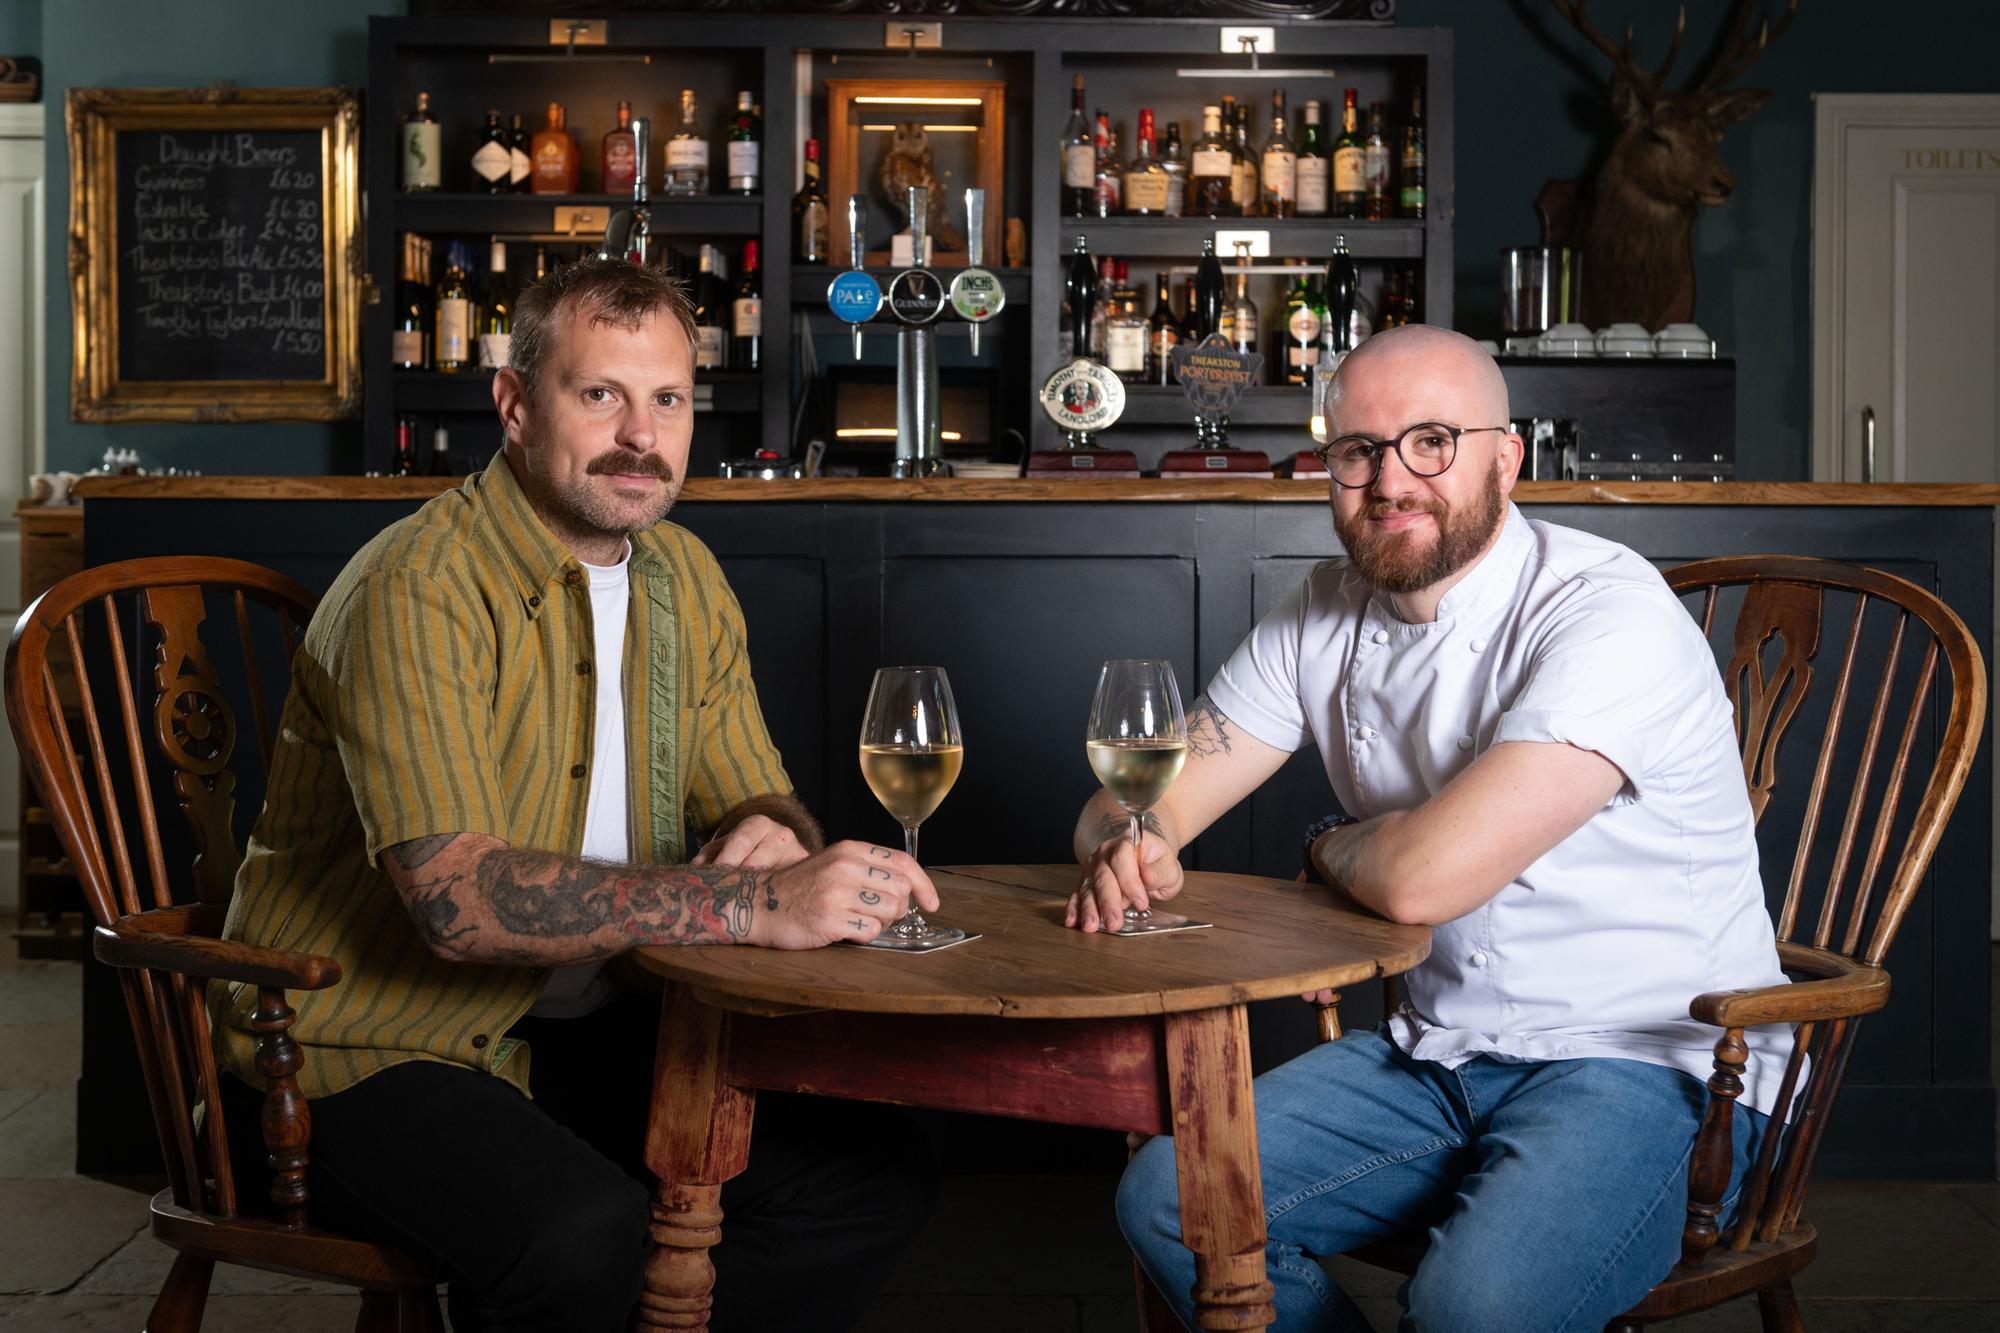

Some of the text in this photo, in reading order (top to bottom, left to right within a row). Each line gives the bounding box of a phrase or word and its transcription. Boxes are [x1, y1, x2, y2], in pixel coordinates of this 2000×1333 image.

[159, 132, 296, 171] Draught Beers
[1900, 148, 2000, 169] TOILETS
[894, 298, 938, 308] GUINNESS
[1190, 355, 1241, 369] THEAKSTON
[1047, 367, 1076, 401] TIMOTHY
[1058, 407, 1108, 424] LANDLORD
